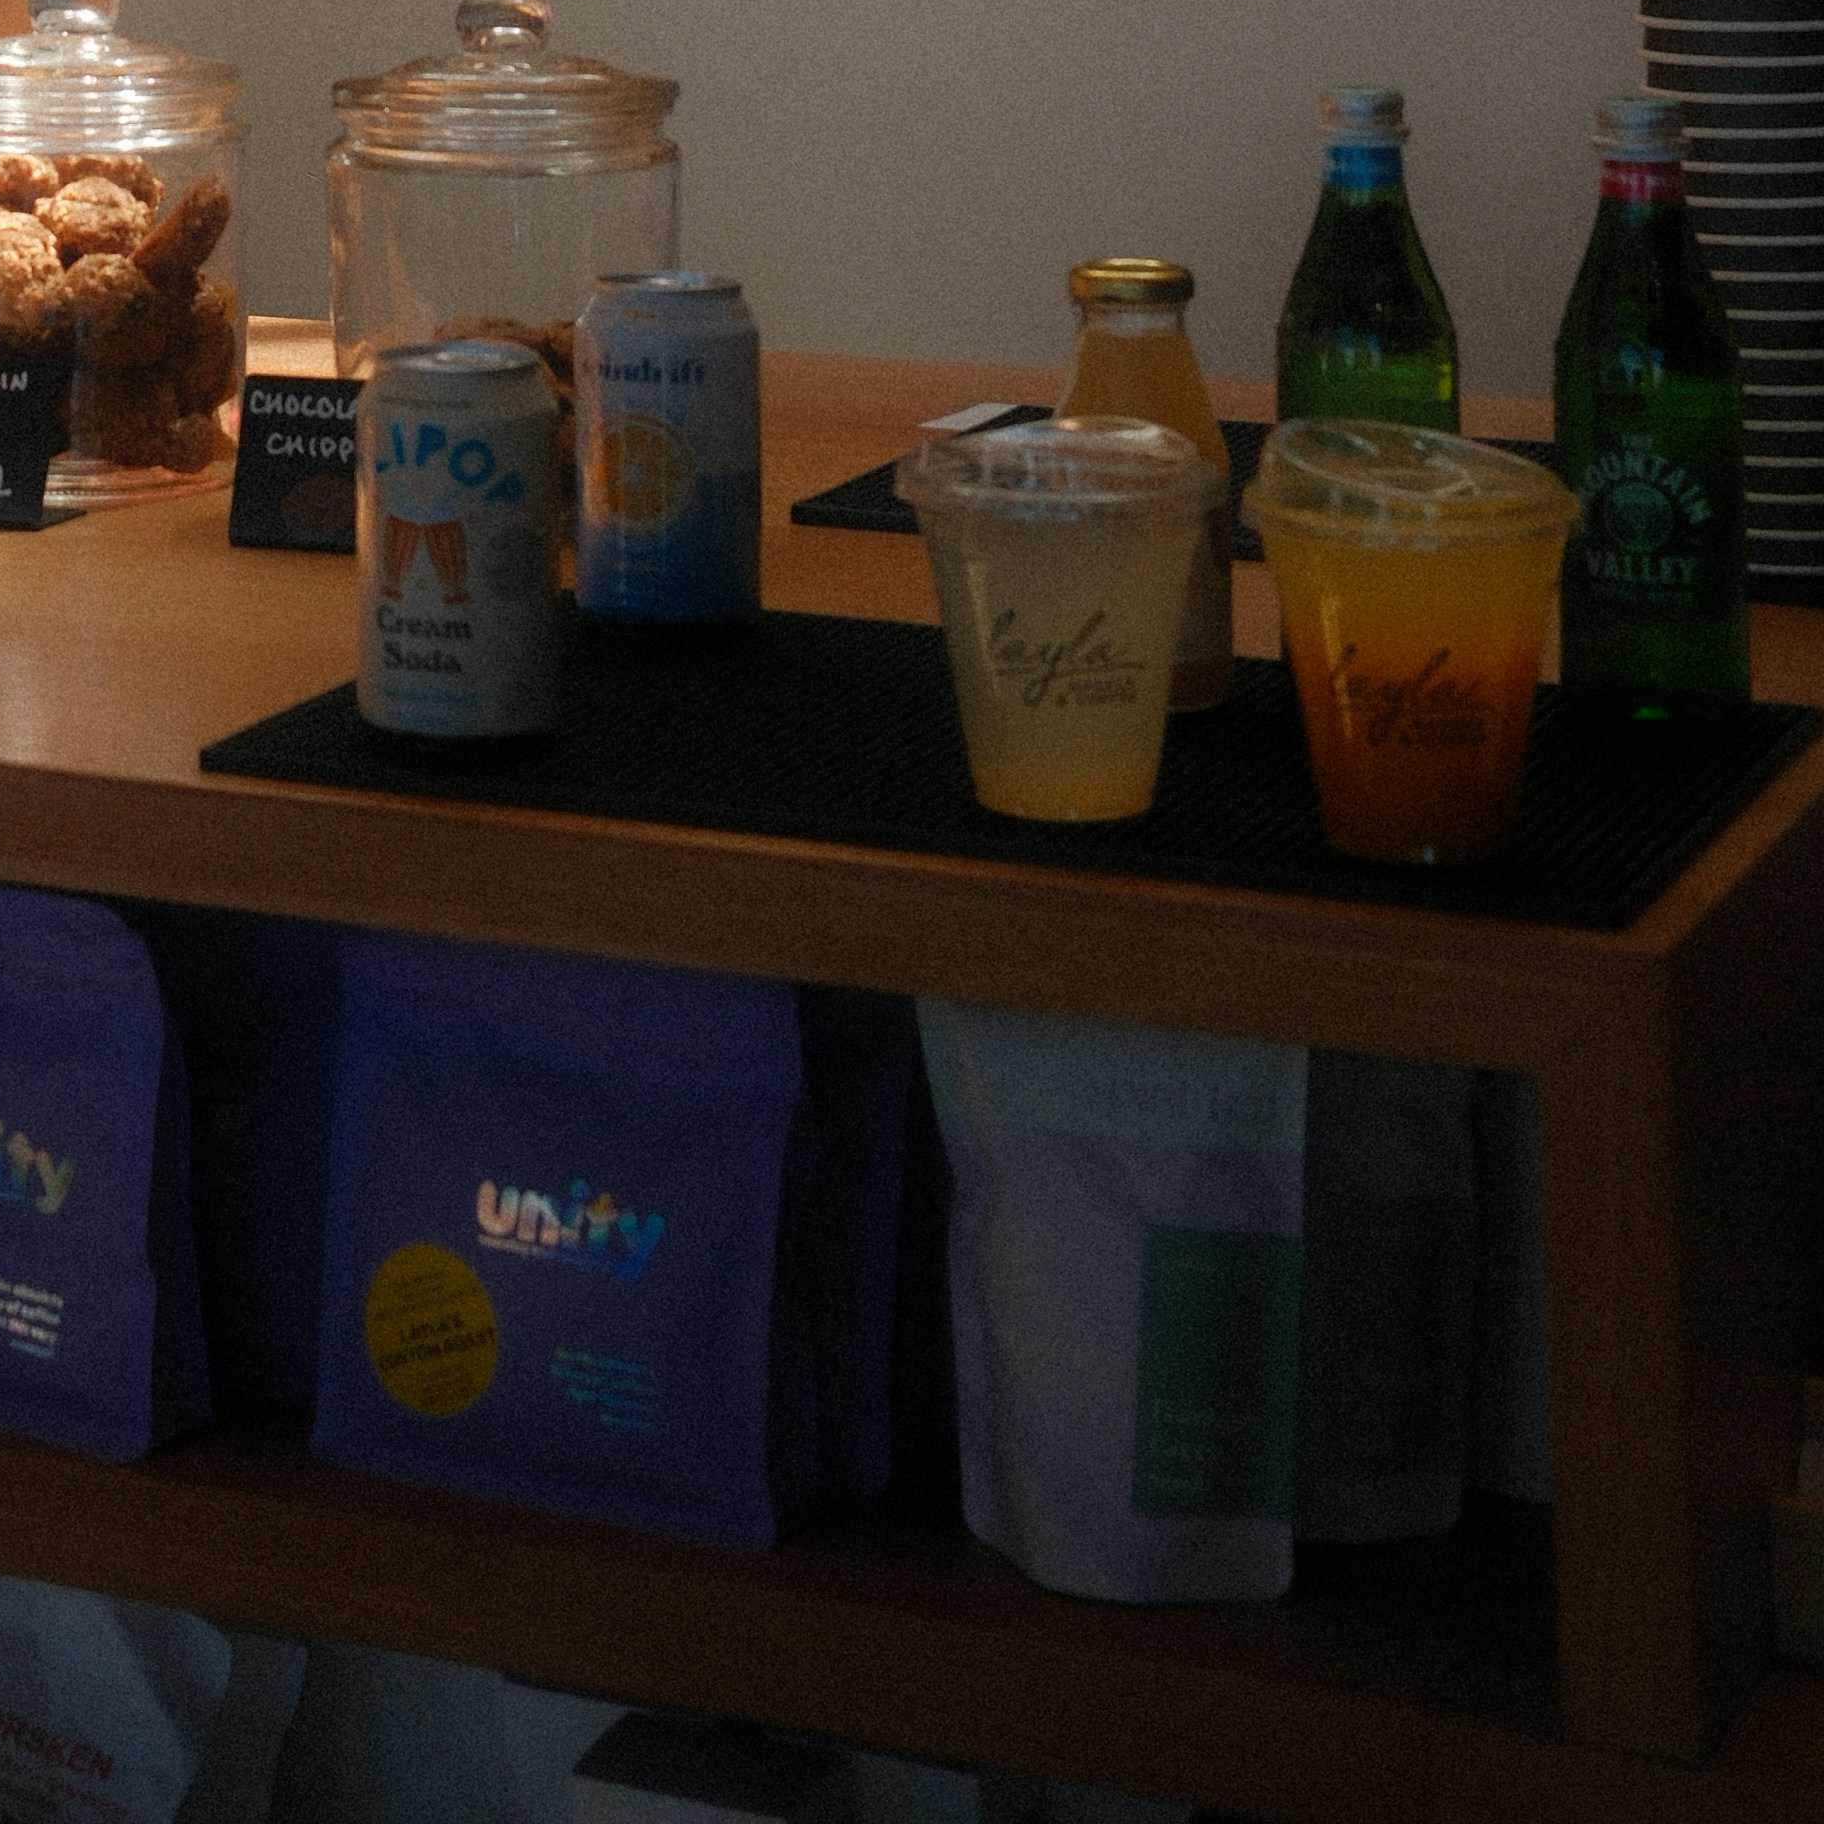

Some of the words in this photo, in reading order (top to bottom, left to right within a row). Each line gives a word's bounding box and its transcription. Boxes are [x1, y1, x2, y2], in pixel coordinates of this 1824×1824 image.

[1585, 551, 1700, 587] VALLEY
[378, 608, 473, 640] Cream
[384, 642, 463, 673] Soda
[475, 1176, 667, 1282] unity
